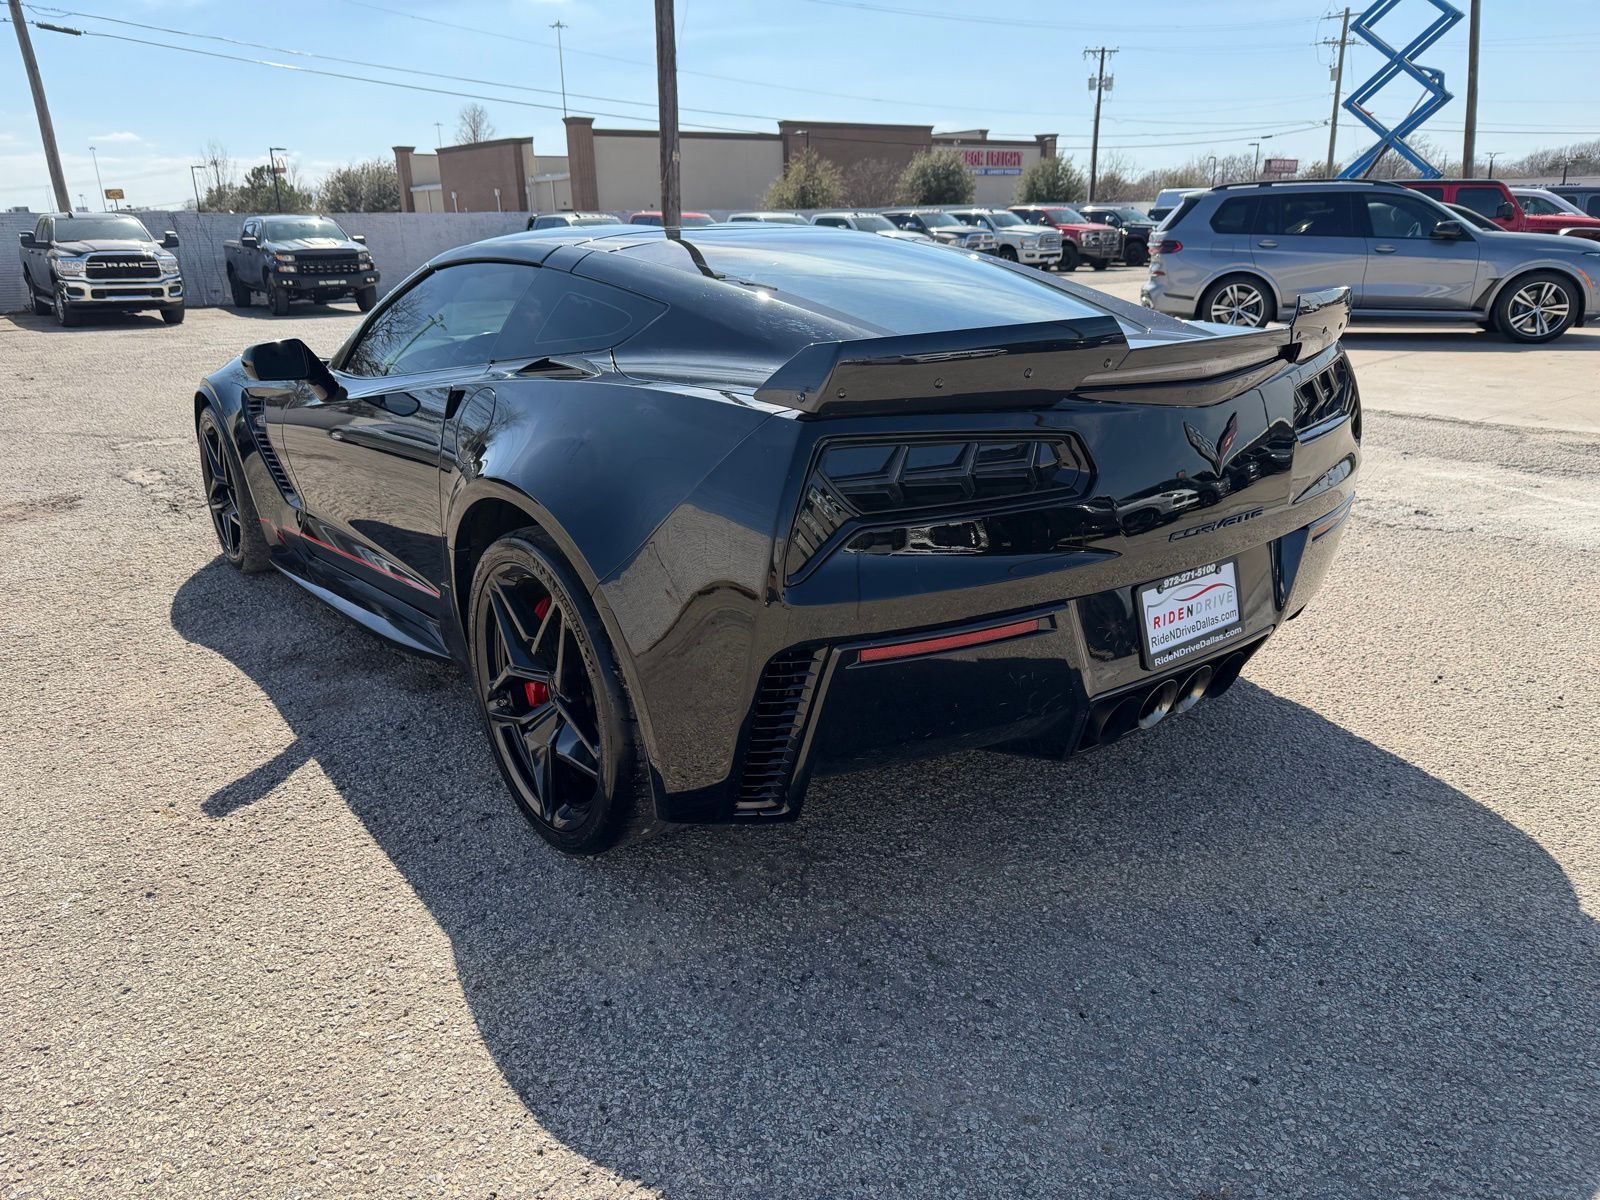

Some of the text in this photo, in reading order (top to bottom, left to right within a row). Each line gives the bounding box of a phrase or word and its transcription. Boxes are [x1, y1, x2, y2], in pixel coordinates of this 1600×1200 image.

[1163, 563, 1216, 588] 972-271-5100
[1151, 609, 1237, 648] RideNDriveDallas.com
[1154, 627, 1243, 667] RideNDriveDallas.com
